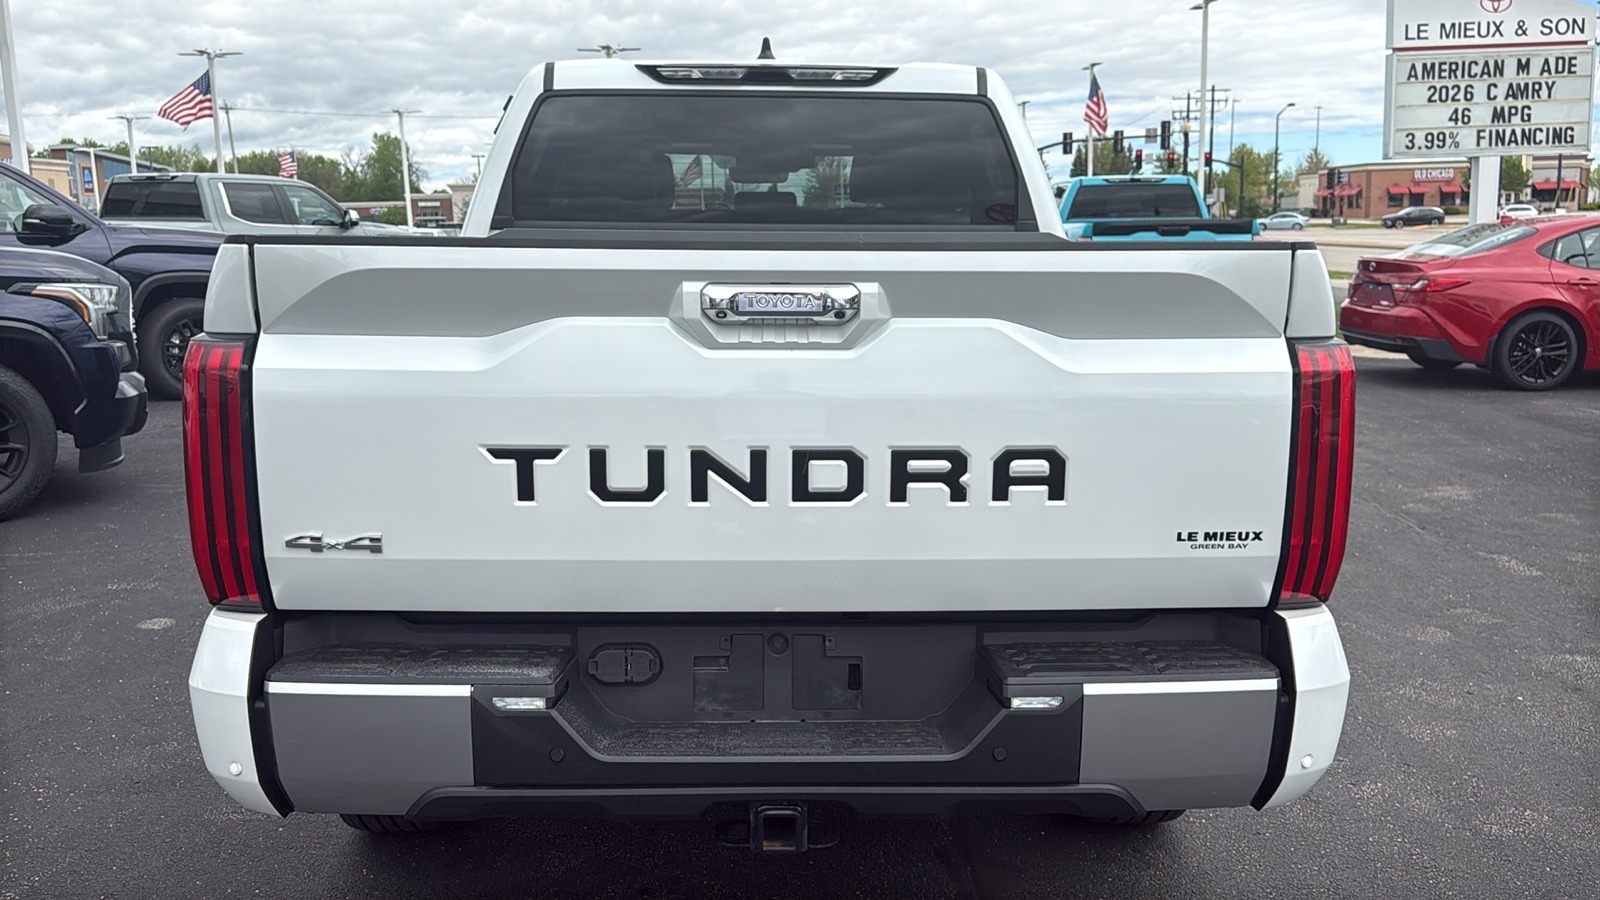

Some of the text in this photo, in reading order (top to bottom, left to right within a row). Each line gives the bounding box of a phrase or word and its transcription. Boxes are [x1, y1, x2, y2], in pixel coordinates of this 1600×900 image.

[1404, 17, 1586, 41] LE MIEUX & SON
[1406, 59, 1505, 81] AMERICAN
[1427, 84, 1474, 104] 2026
[1448, 105, 1532, 125] 46 MPG
[1404, 126, 1575, 150] 3.99% FINANCING
[744, 293, 816, 309] TOYOTA
[479, 445, 1069, 507] TUNDRA
[1176, 531, 1264, 542] LE MIEUX
